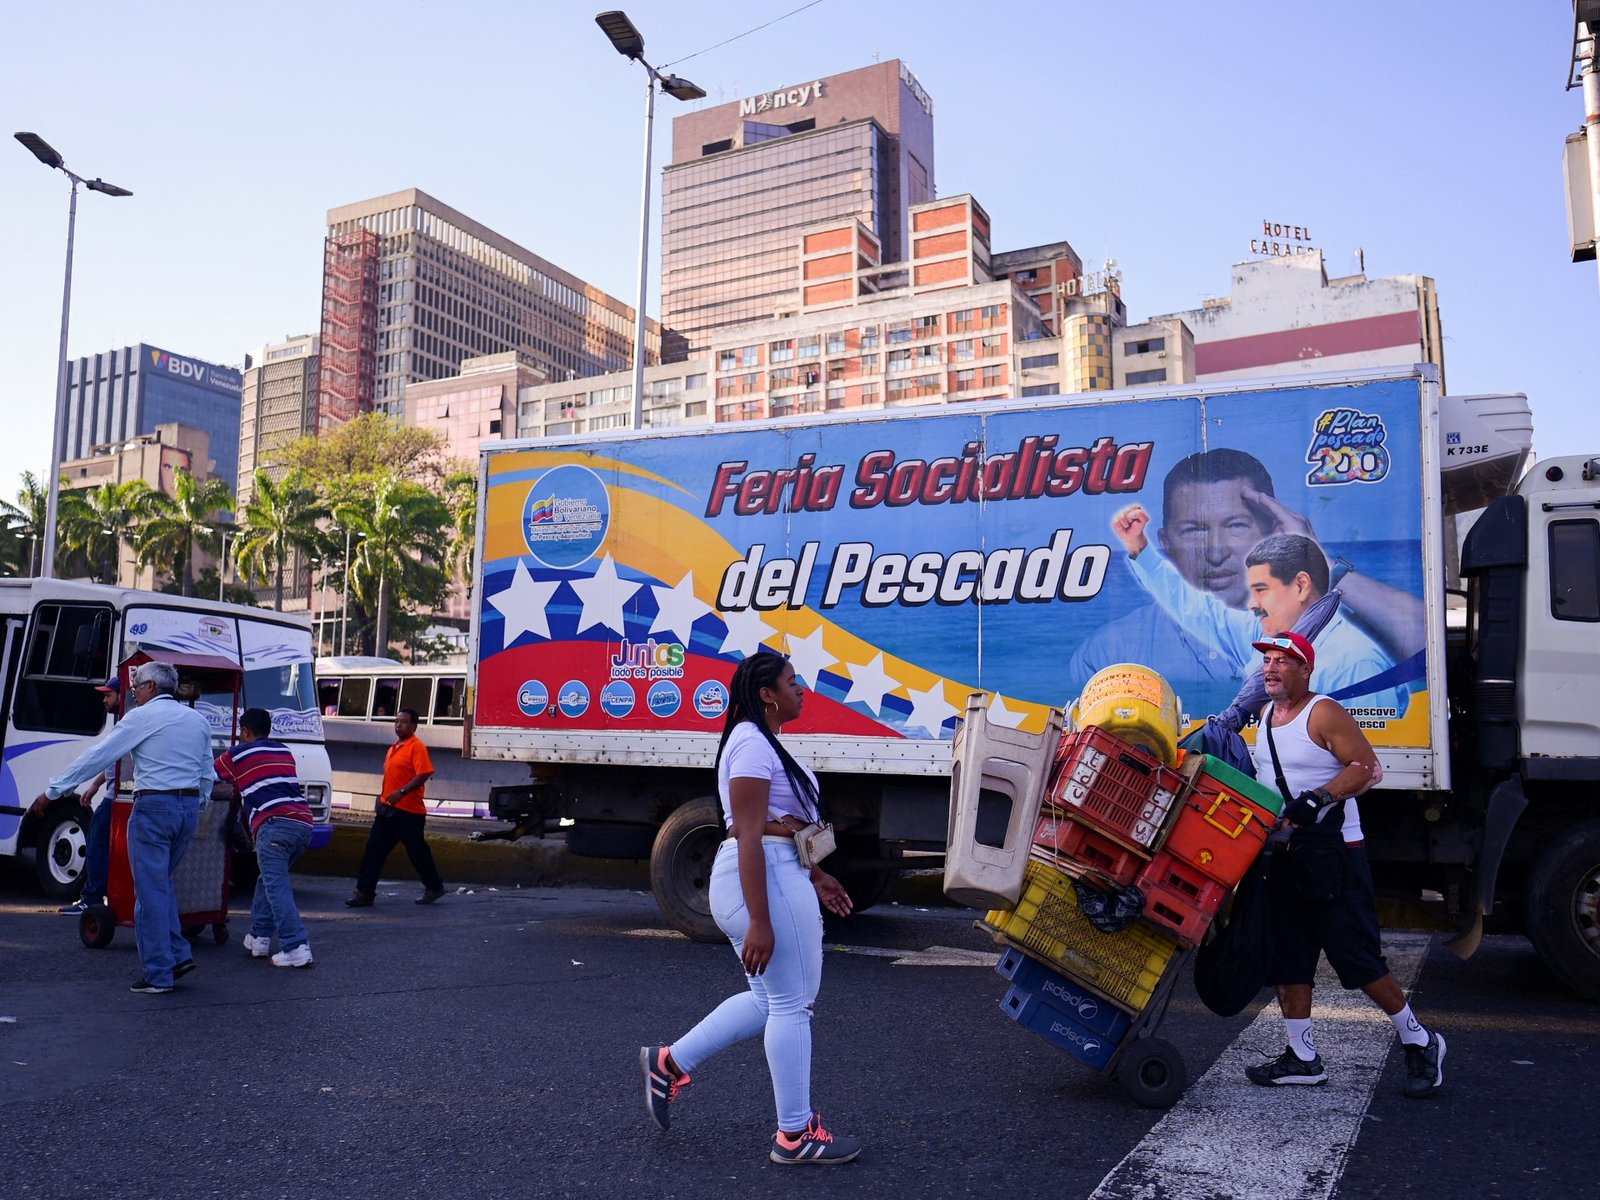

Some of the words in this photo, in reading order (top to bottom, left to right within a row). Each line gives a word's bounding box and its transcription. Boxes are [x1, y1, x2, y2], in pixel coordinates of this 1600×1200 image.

[1264, 222, 1311, 241] HOTEL
[168, 356, 205, 381] BDV
[1312, 426, 1384, 454] pescado
[1447, 447, 1456, 456] K
[1459, 444, 1489, 455] 733E
[704, 453, 845, 517] Feria
[850, 434, 1154, 509] Socialista
[1308, 445, 1389, 484] 200
[554, 499, 587, 507] Gobierno
[554, 505, 597, 513] Bolivariano
[565, 512, 601, 520] Venezuela
[716, 541, 821, 611] del
[820, 529, 1110, 609] Pescado
[129, 622, 148, 635] 40
[611, 638, 685, 667] Juntos
[611, 668, 631, 678] todo
[633, 669, 647, 677] es
[649, 668, 684, 680] posible
[1042, 980, 1082, 1007] pepsi
[1050, 1021, 1087, 1046] pepsi
